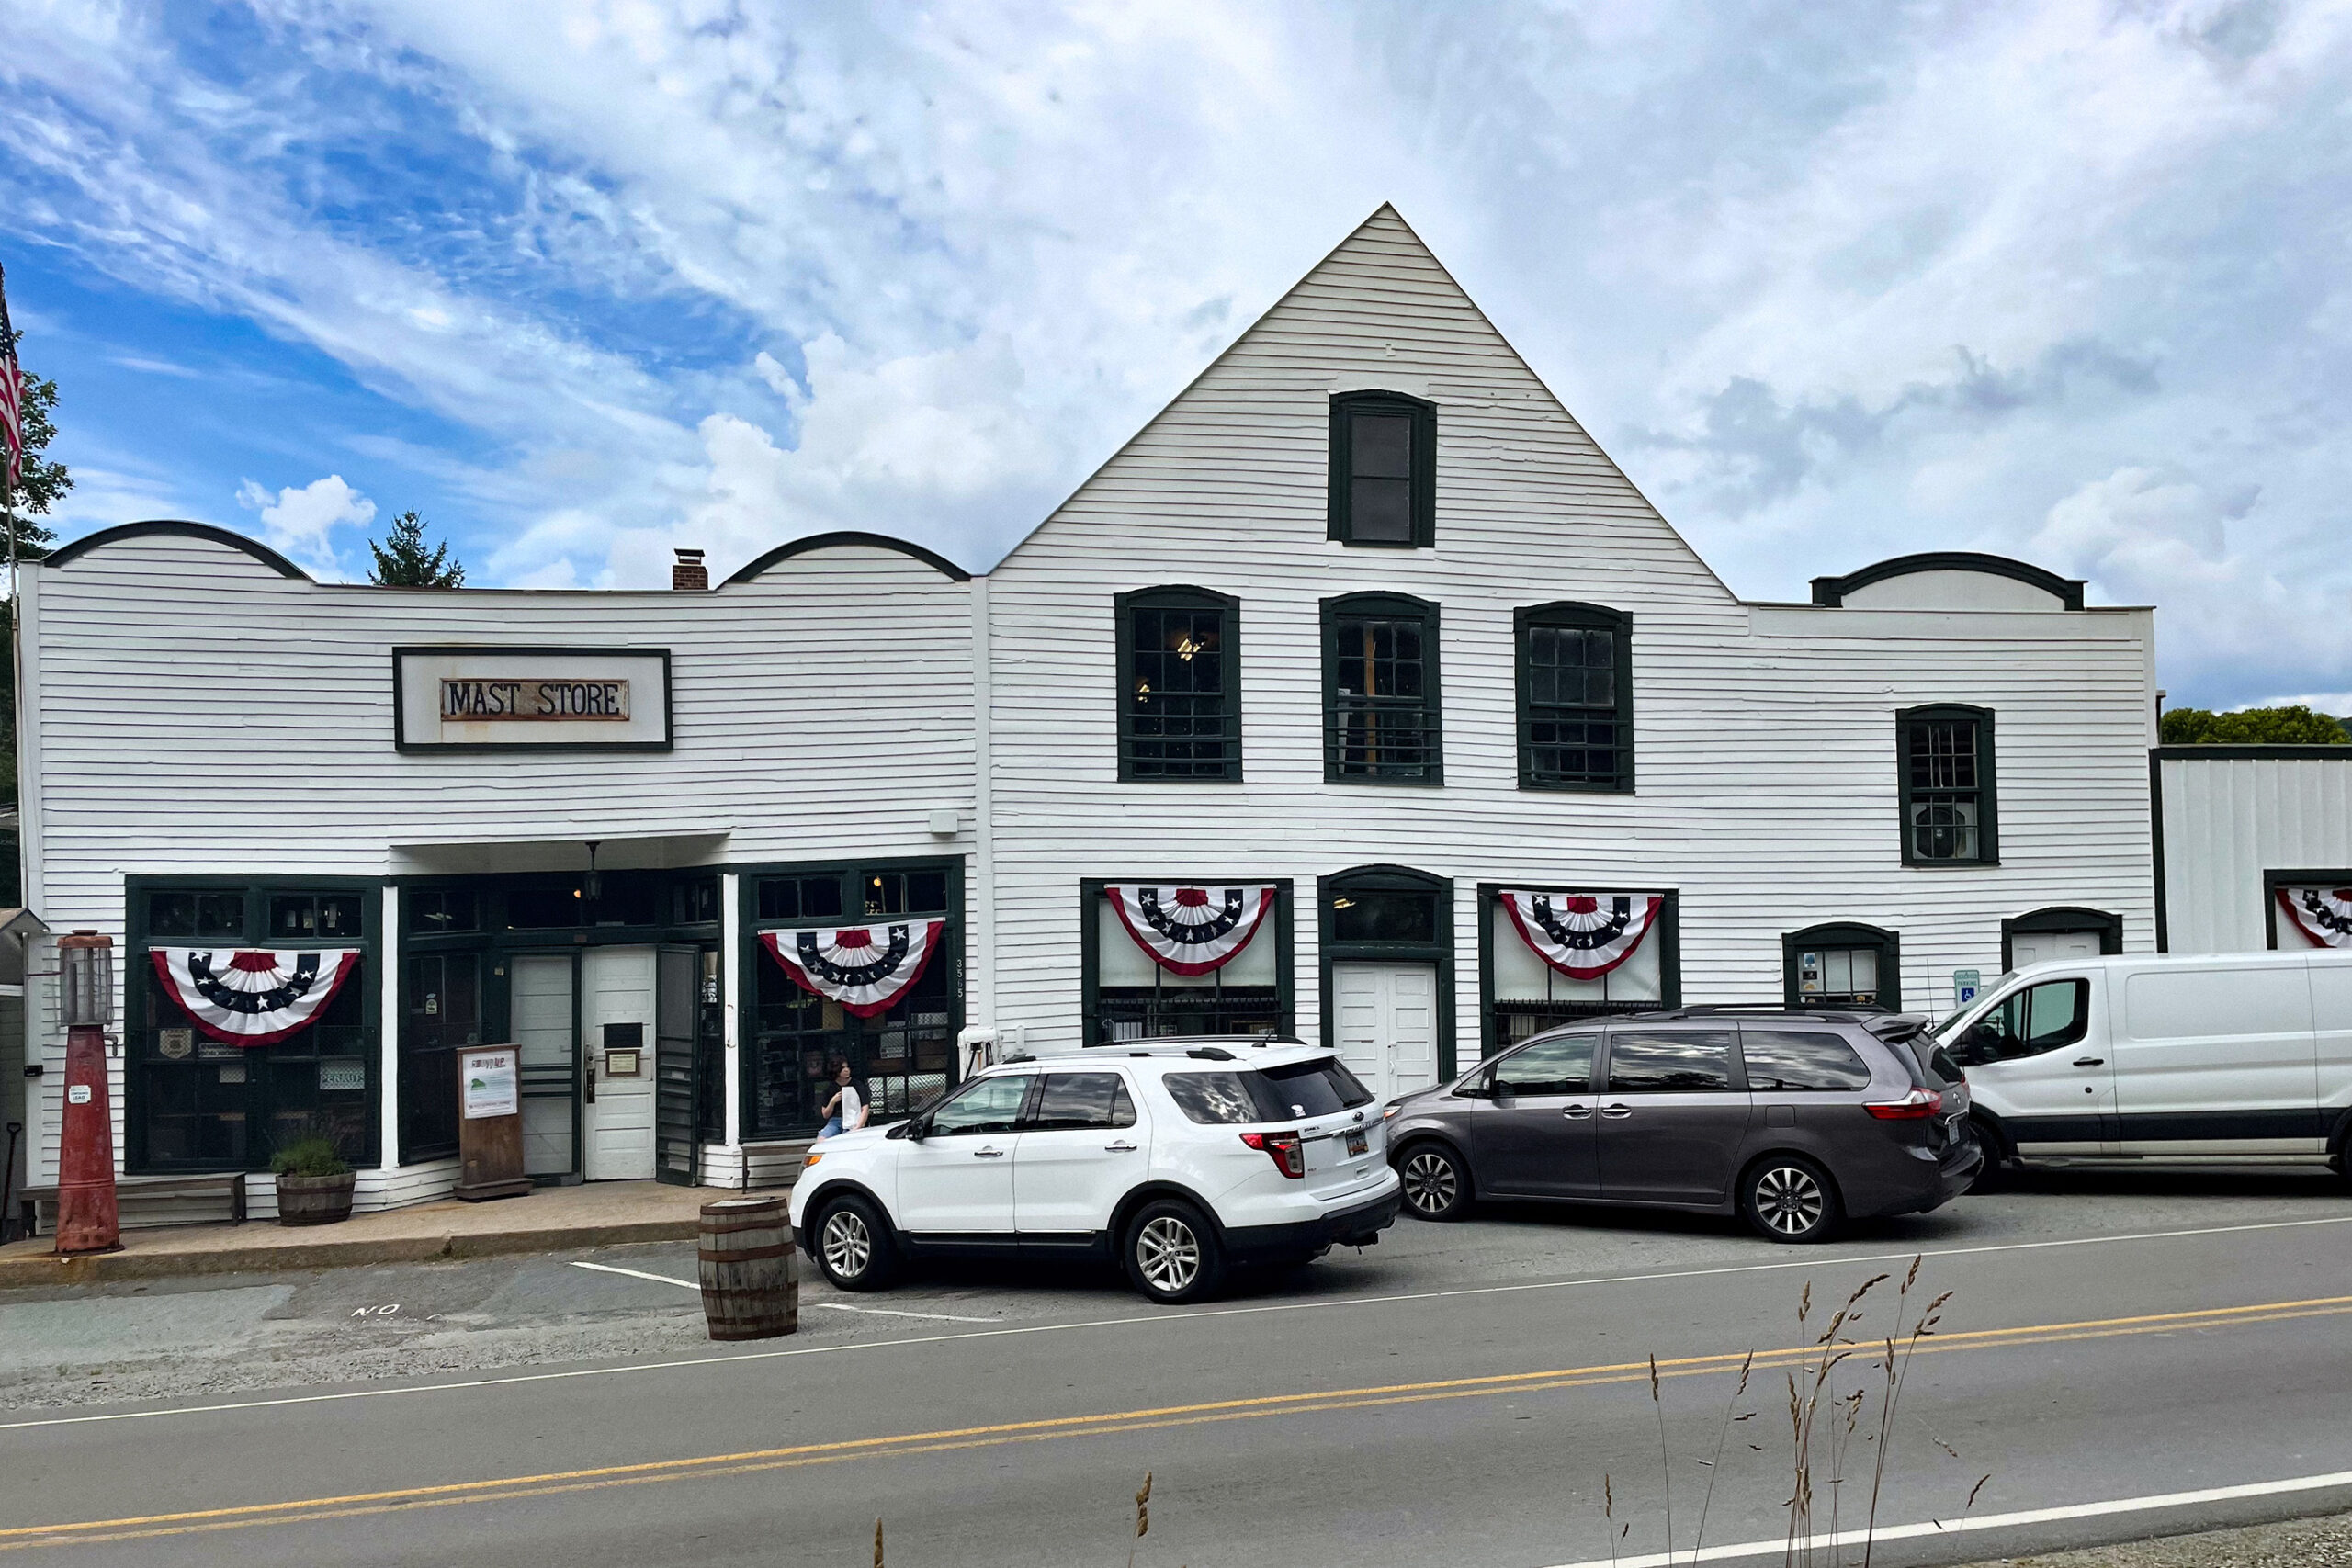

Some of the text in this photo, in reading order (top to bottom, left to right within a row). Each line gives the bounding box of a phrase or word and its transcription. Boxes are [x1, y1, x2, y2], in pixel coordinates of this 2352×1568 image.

[449, 683, 620, 716] MAST STORE
[350, 1303, 401, 1317] NO
